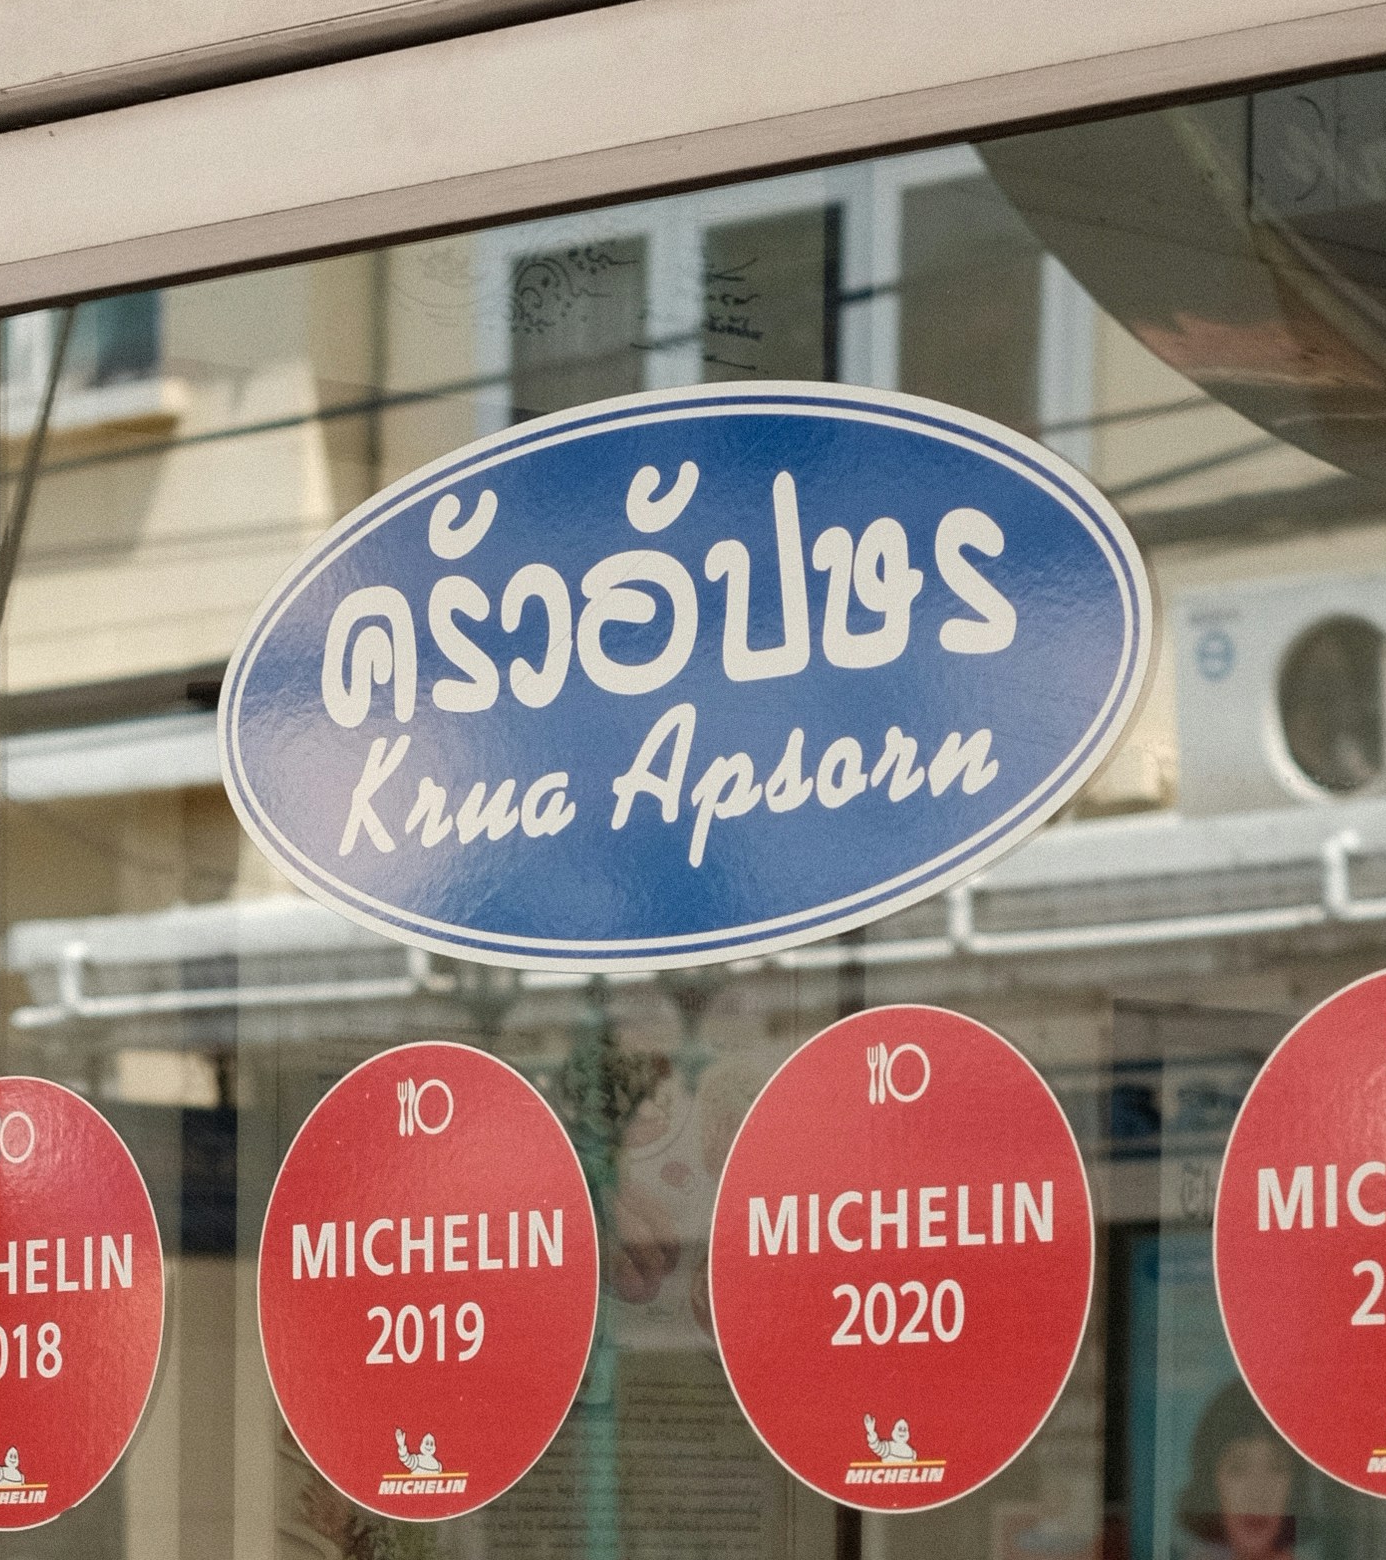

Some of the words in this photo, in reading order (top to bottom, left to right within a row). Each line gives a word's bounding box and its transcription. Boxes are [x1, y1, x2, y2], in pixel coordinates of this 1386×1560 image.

[321, 461, 1018, 728] ครัวอัปษร
[337, 734, 576, 858] Krua
[611, 702, 1001, 869] Apsorn
[292, 1209, 565, 1281] MICHELIN
[749, 1181, 1055, 1258] MICHELIN
[366, 1301, 486, 1366] 2019
[832, 1279, 966, 1347] 2020
[378, 1477, 468, 1496] MICHELIN
[845, 1466, 946, 1486] MICHELIN
